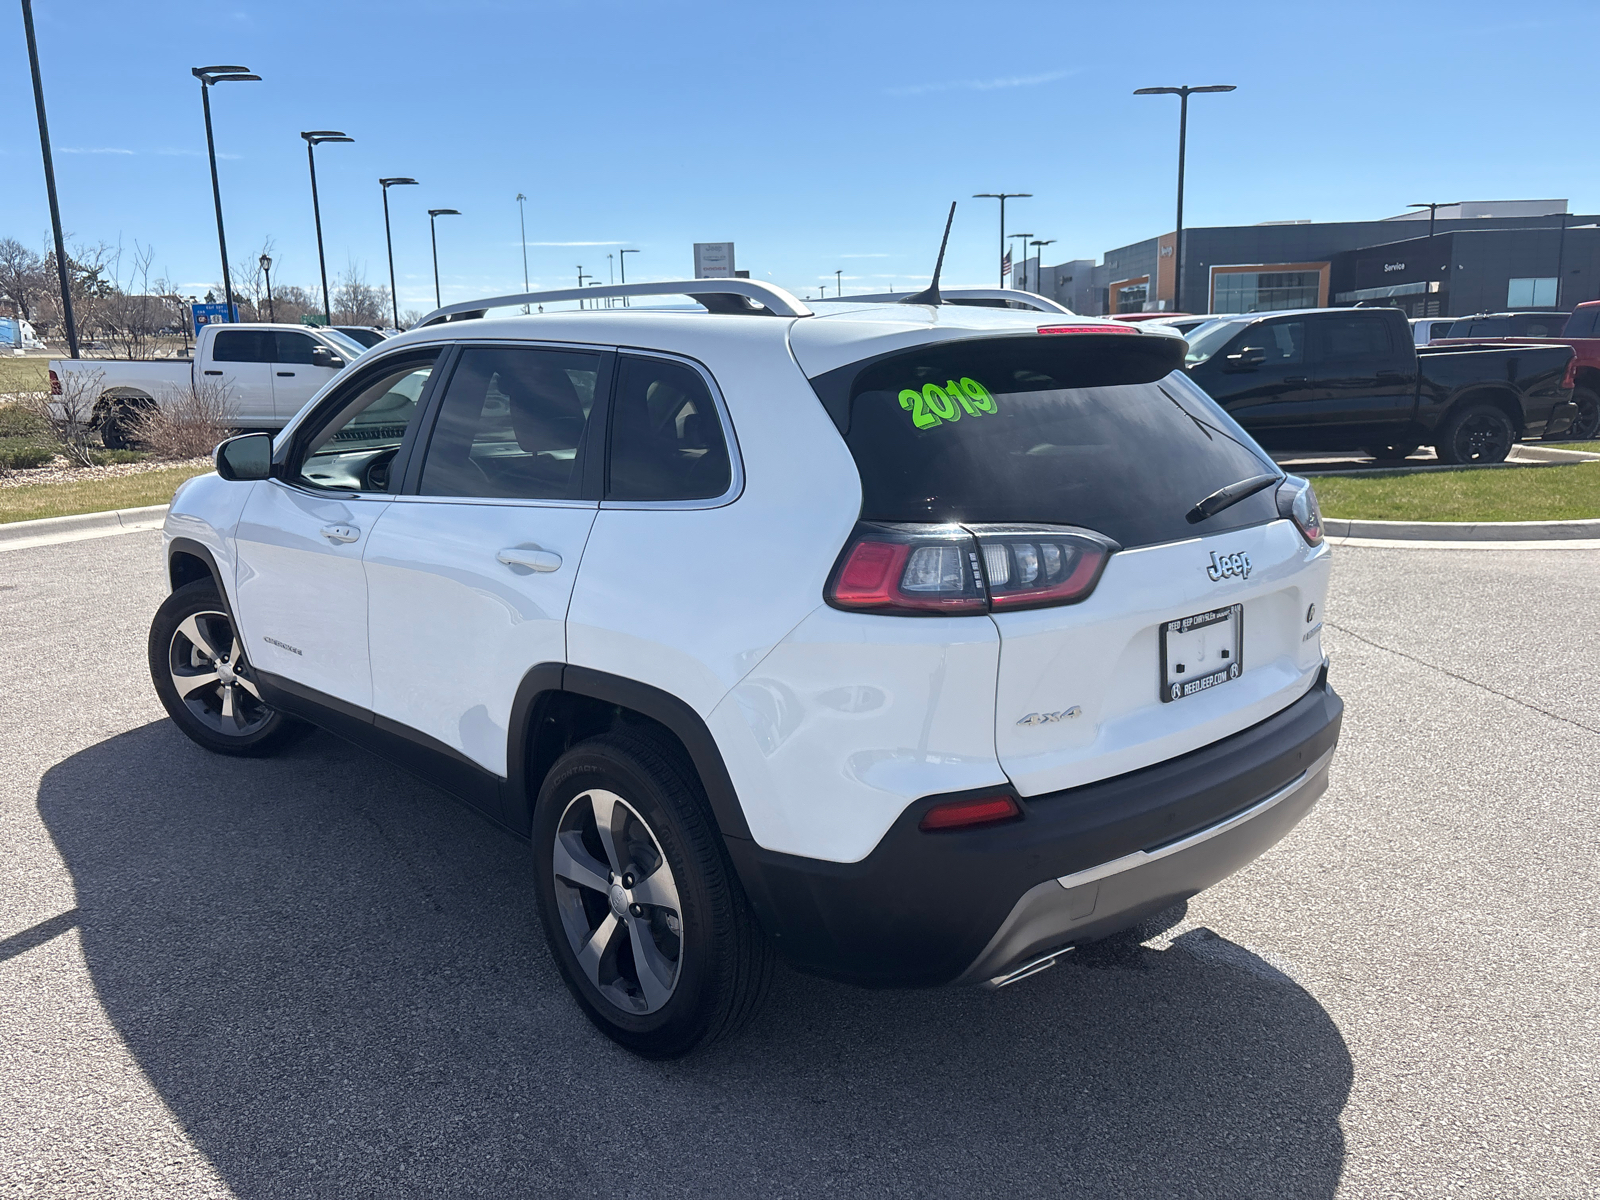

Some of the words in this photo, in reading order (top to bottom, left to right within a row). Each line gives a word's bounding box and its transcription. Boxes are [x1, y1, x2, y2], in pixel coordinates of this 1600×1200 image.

[1384, 262, 1405, 272] Service
[898, 377, 998, 430] 2019
[1207, 551, 1252, 582] Jeep
[1168, 621, 1181, 632] REED
[1182, 617, 1193, 628] JEEP
[1184, 671, 1227, 695] REEDJEEP.COM
